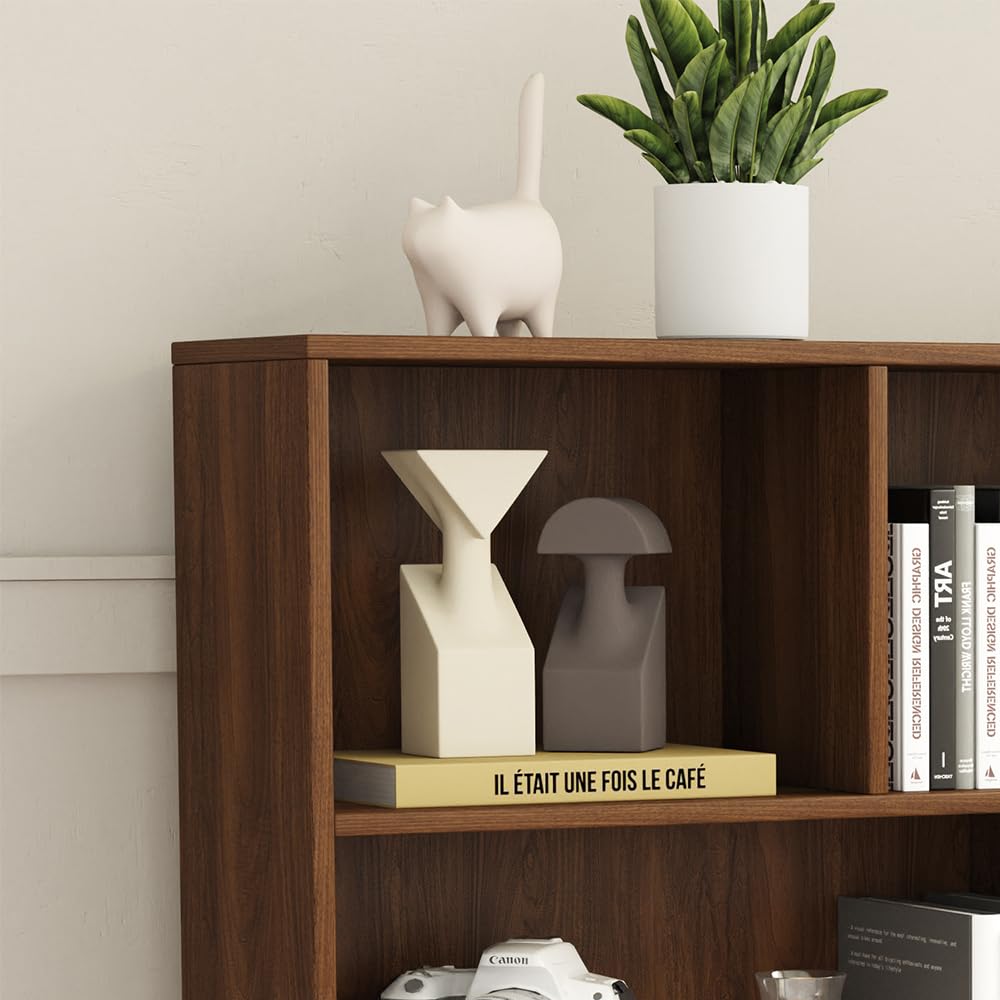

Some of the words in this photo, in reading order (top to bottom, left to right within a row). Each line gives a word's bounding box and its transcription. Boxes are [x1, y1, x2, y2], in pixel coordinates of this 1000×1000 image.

[494, 773, 509, 795] IL
[514, 769, 559, 795] ÉTAIT
[564, 771, 597, 793] UNE
[601, 769, 637, 792] FOIS
[642, 769, 661, 790] LE
[665, 763, 706, 790] CAFÉ
[488, 954, 529, 966] Canon
